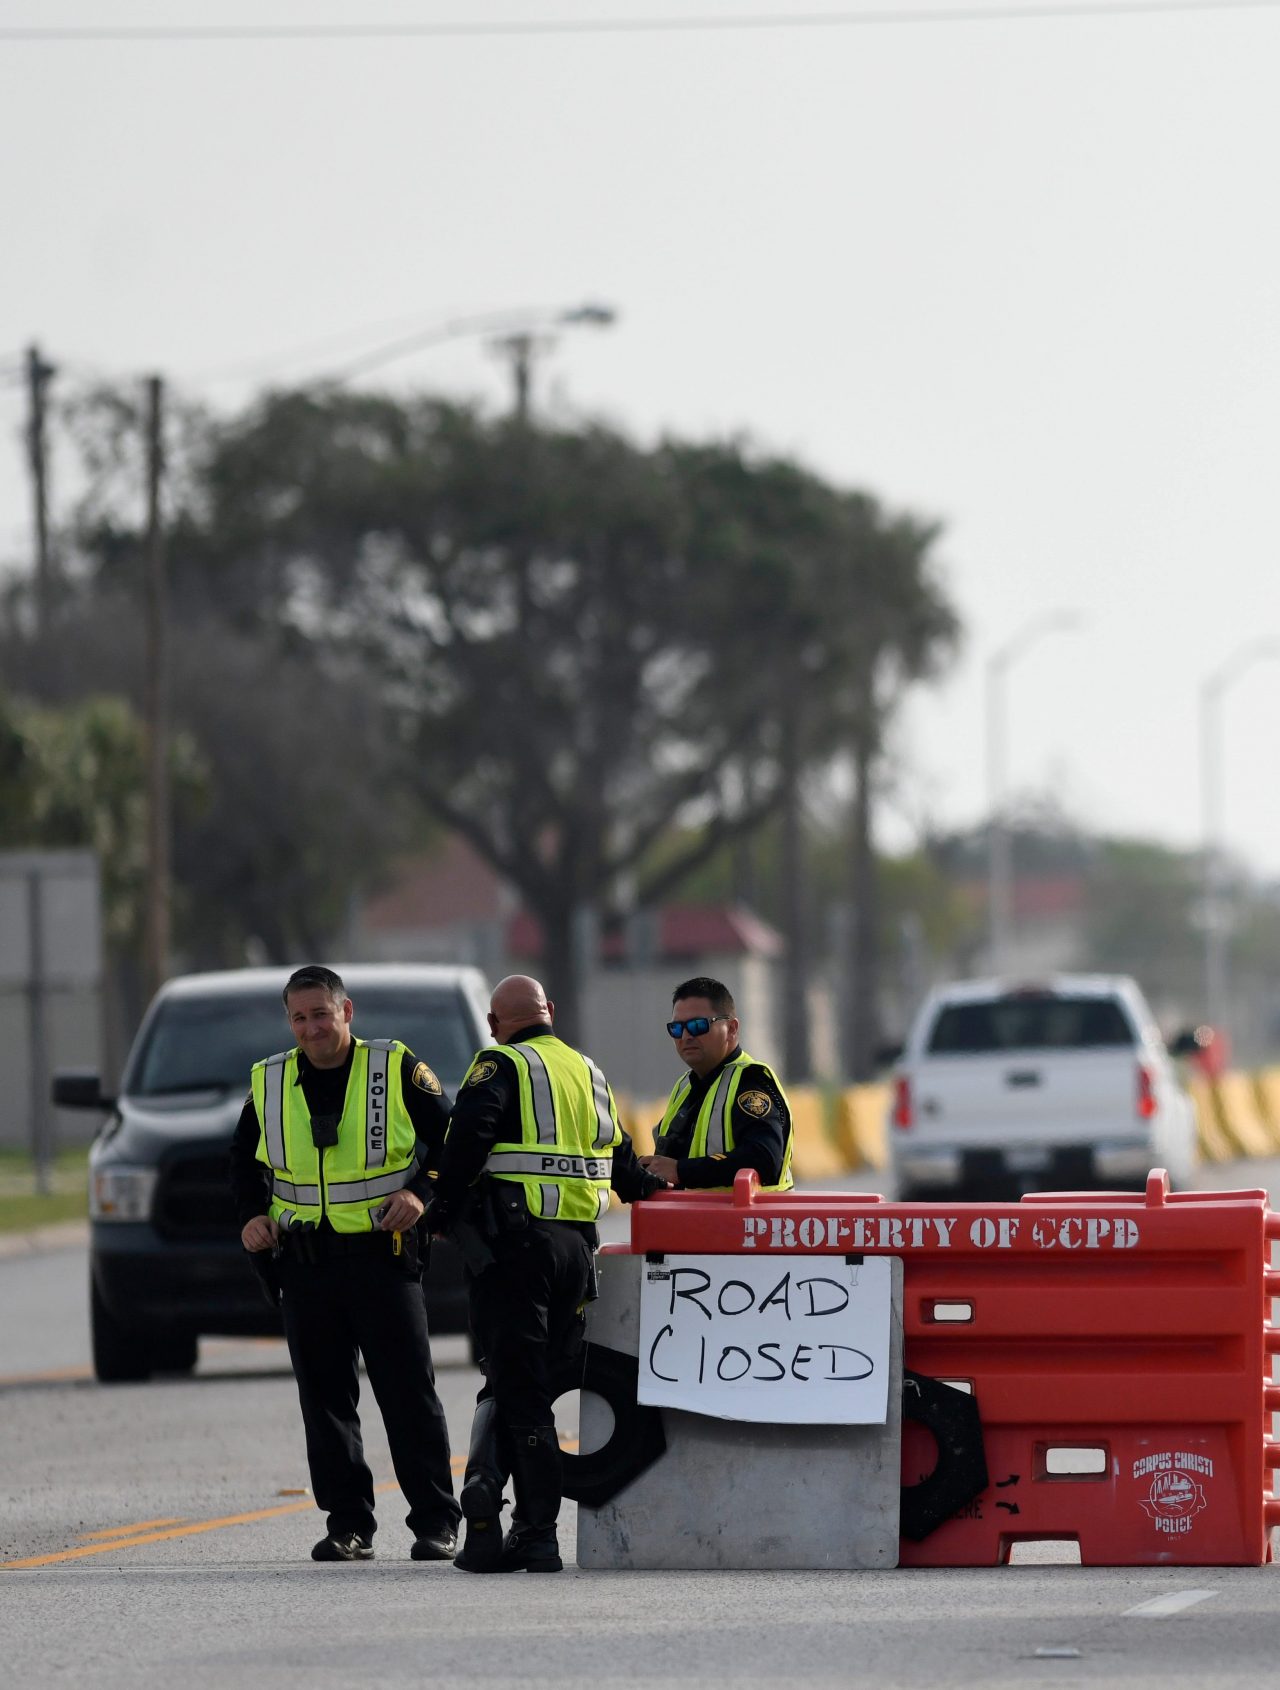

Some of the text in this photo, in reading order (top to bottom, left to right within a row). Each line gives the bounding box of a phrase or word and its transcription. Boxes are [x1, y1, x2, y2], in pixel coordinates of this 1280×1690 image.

[370, 1072, 385, 1150] POLICE
[541, 1157, 606, 1177] POLCE
[742, 1217, 1140, 1249] PROPERTY OF CCPD
[670, 1267, 850, 1321] ROAD
[1133, 1451, 1213, 1479] CORPUS CHRISTI
[1155, 1515, 1192, 1533] POLICE
